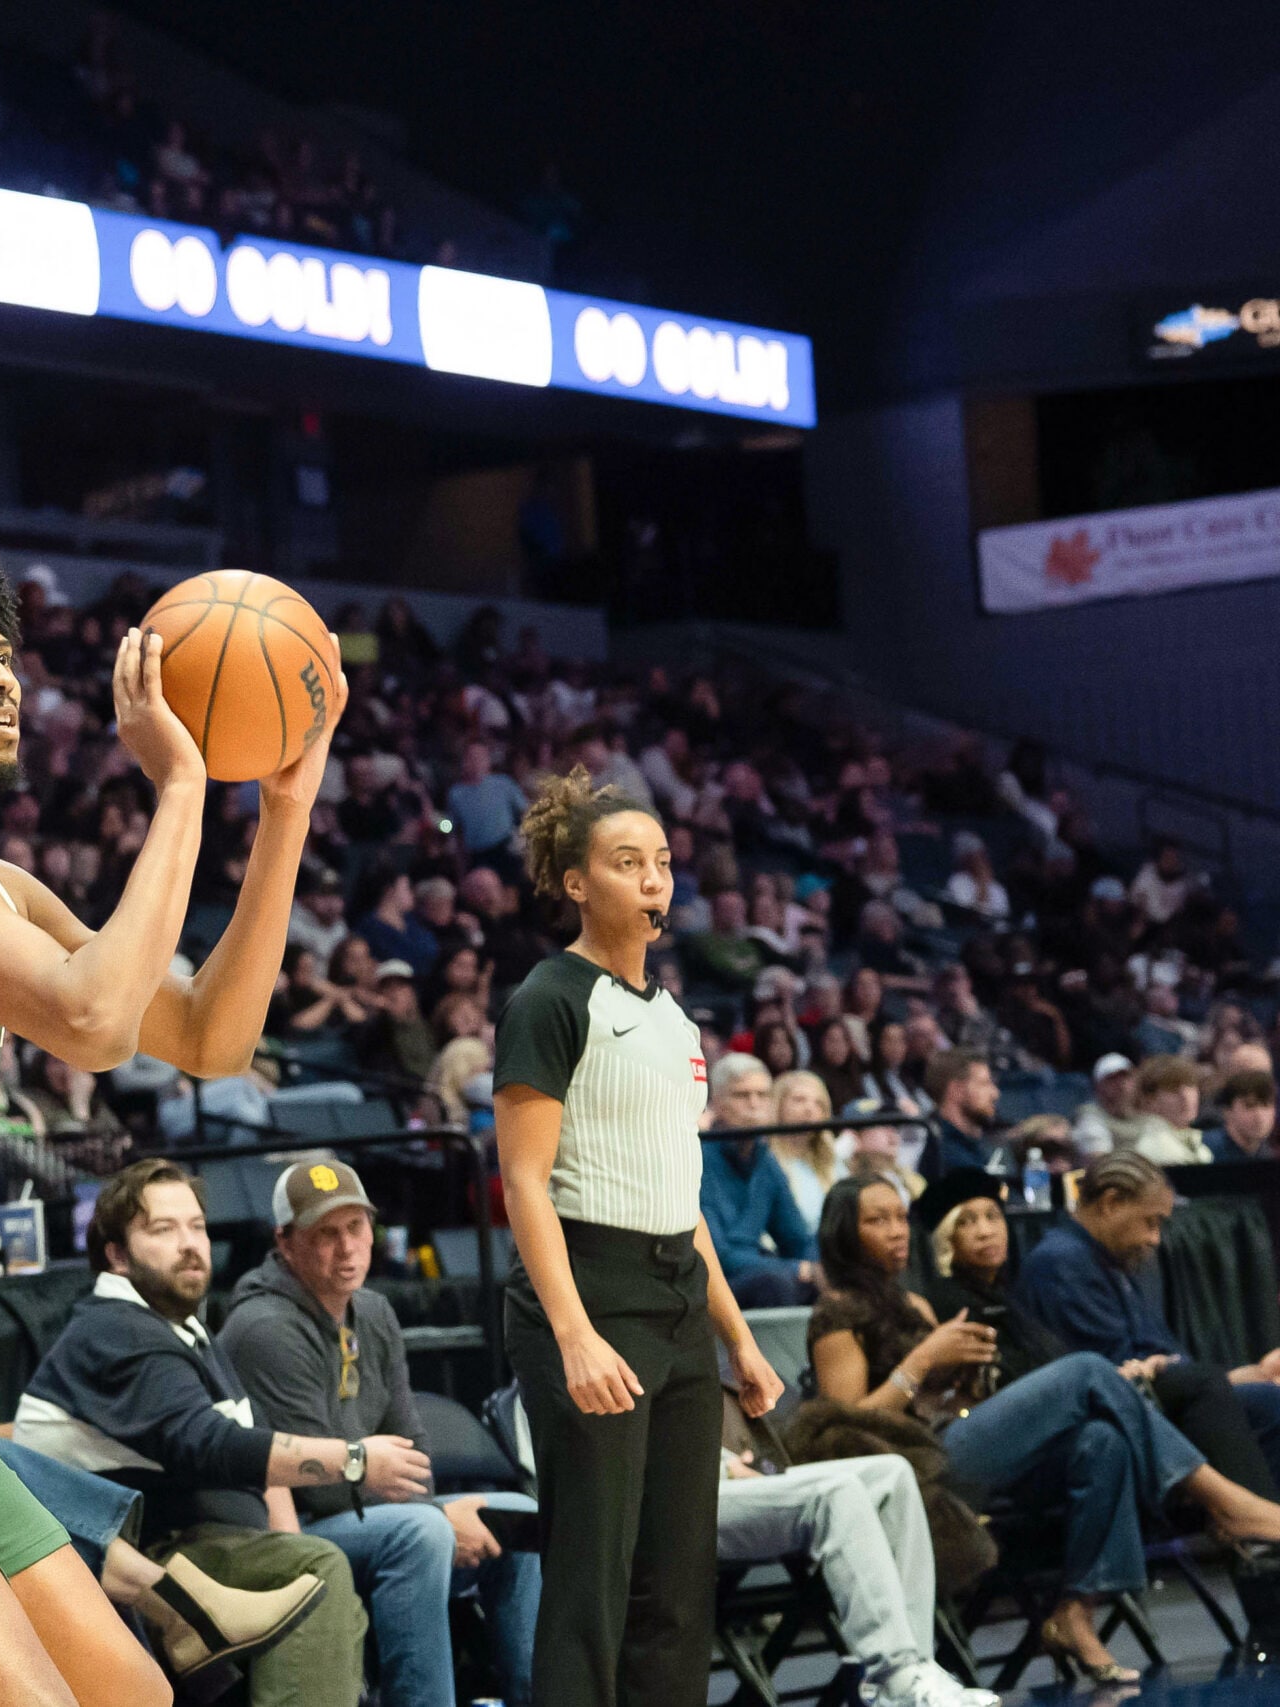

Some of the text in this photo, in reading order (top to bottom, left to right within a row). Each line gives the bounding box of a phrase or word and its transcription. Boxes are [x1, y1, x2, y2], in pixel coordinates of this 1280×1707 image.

[129, 228, 217, 318] GO
[225, 245, 393, 346] GOLD!
[573, 307, 648, 387] GO
[651, 321, 790, 412] GOLD!
